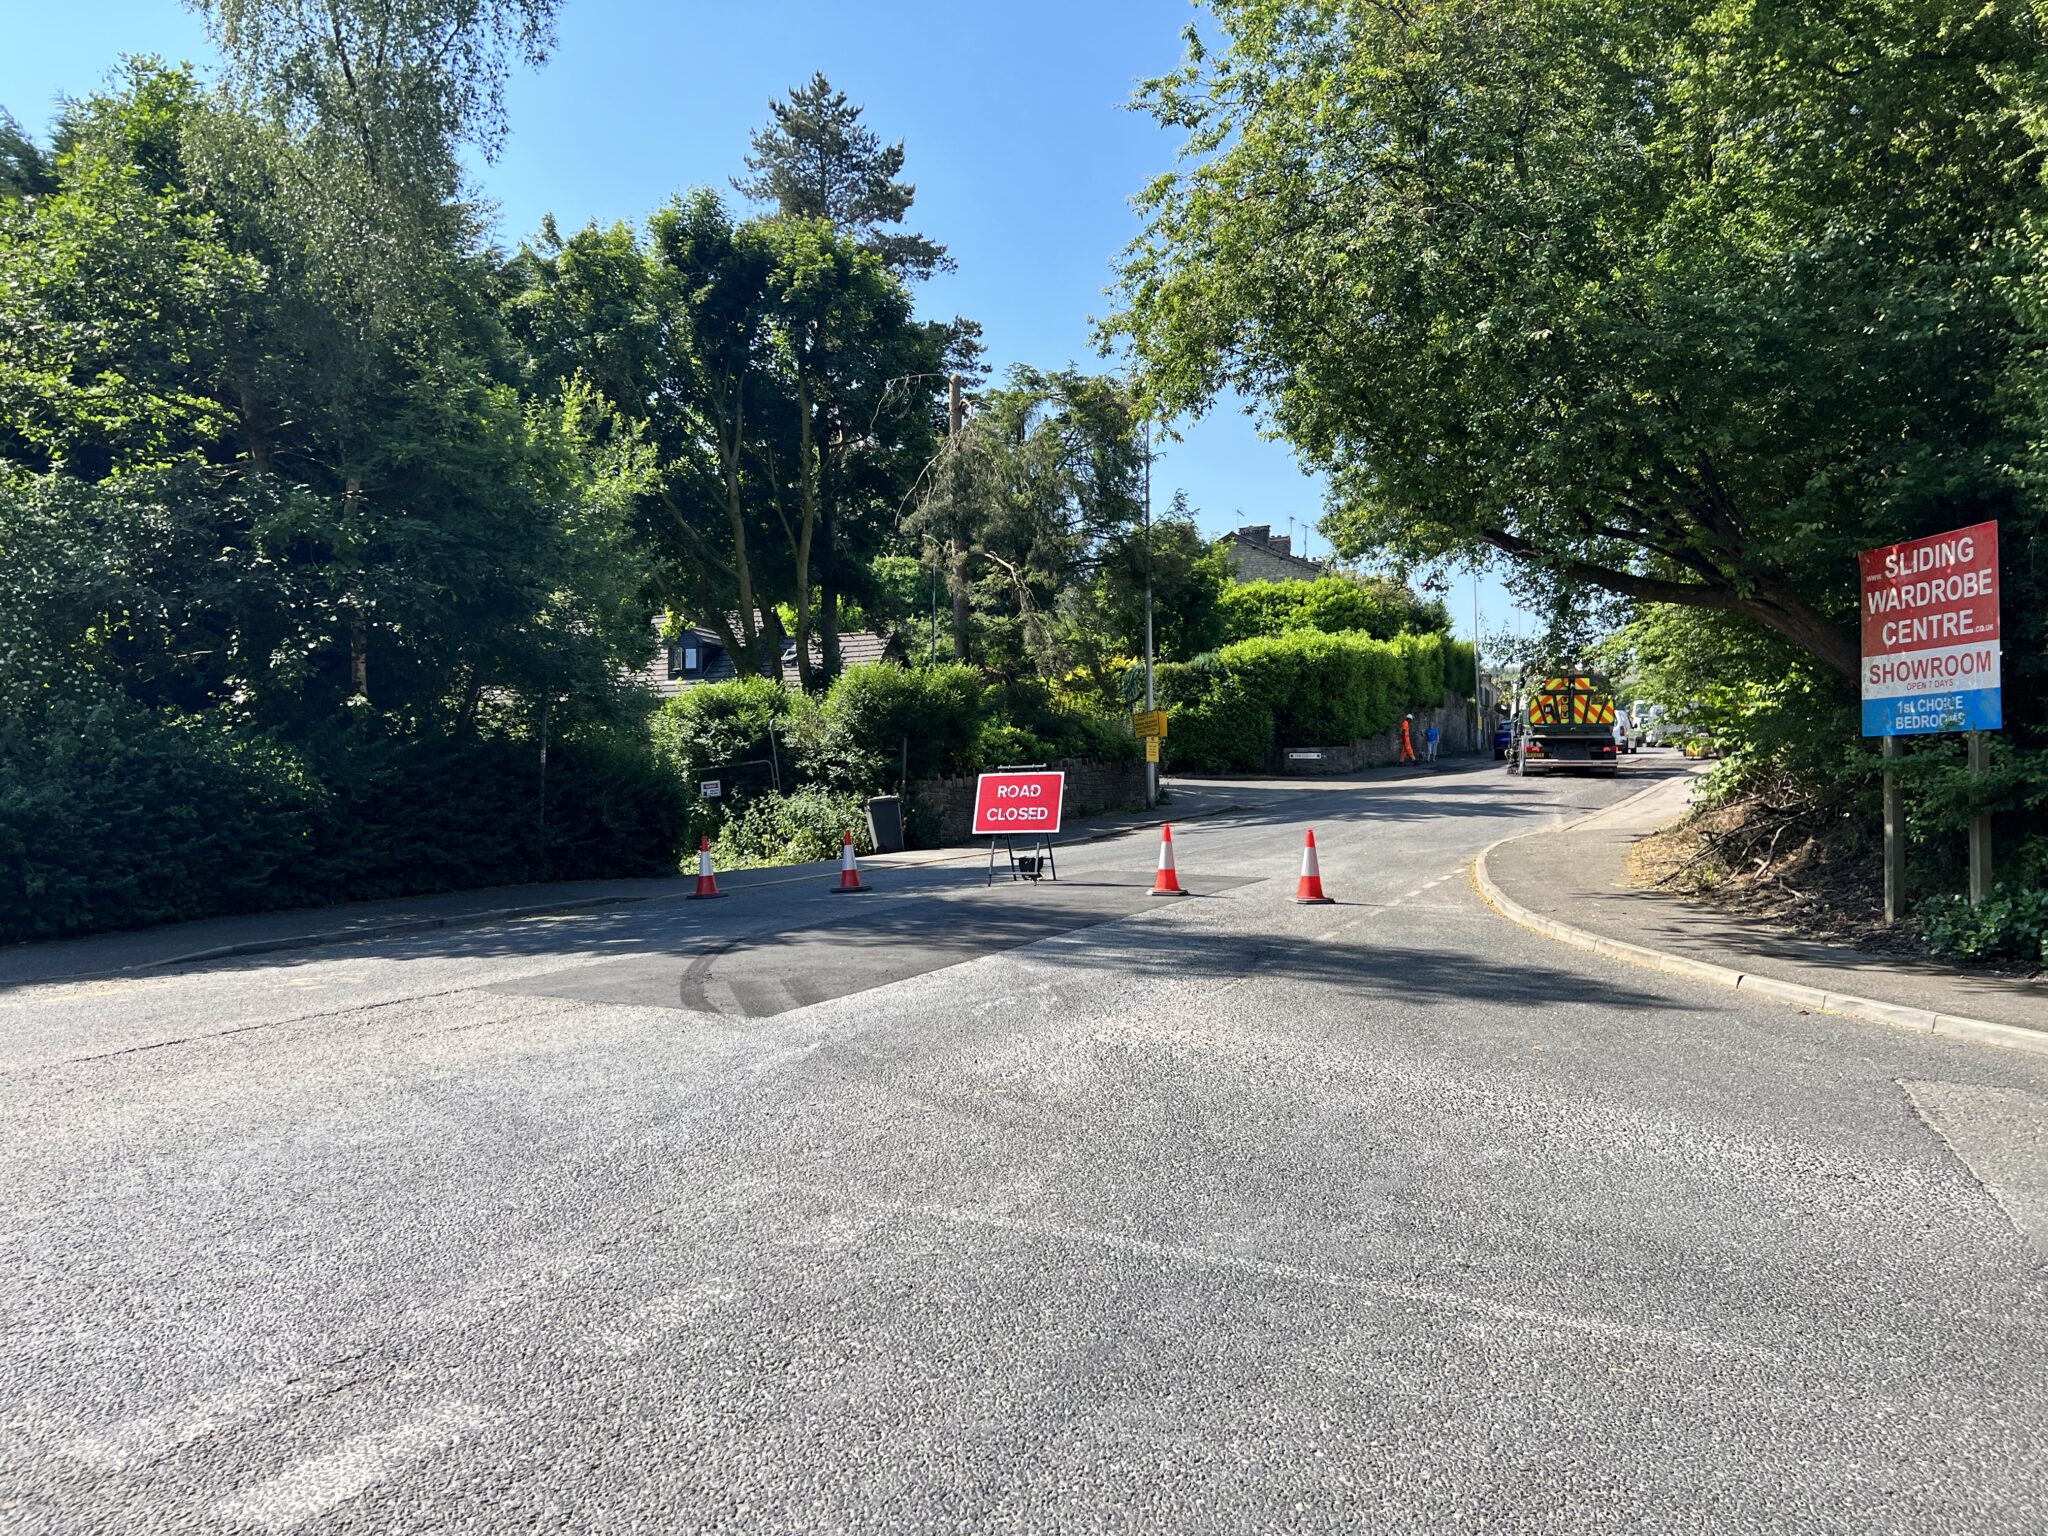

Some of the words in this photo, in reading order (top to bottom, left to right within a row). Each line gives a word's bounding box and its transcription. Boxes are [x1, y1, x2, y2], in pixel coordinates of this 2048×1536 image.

[1885, 537, 1974, 579] SLIDING
[1867, 568, 1993, 615] WARDROBE
[1882, 609, 1974, 646] CENTRE
[1869, 650, 1992, 685] SHOWROOM
[1906, 682, 1927, 691] OPEN
[1929, 680, 1933, 688] 7
[1934, 679, 1954, 688] DAYS
[1897, 700, 1916, 714] 1st
[1917, 695, 1964, 713] CHOICE
[997, 784, 1041, 798] ROAD
[986, 806, 1048, 821] CLOSED
